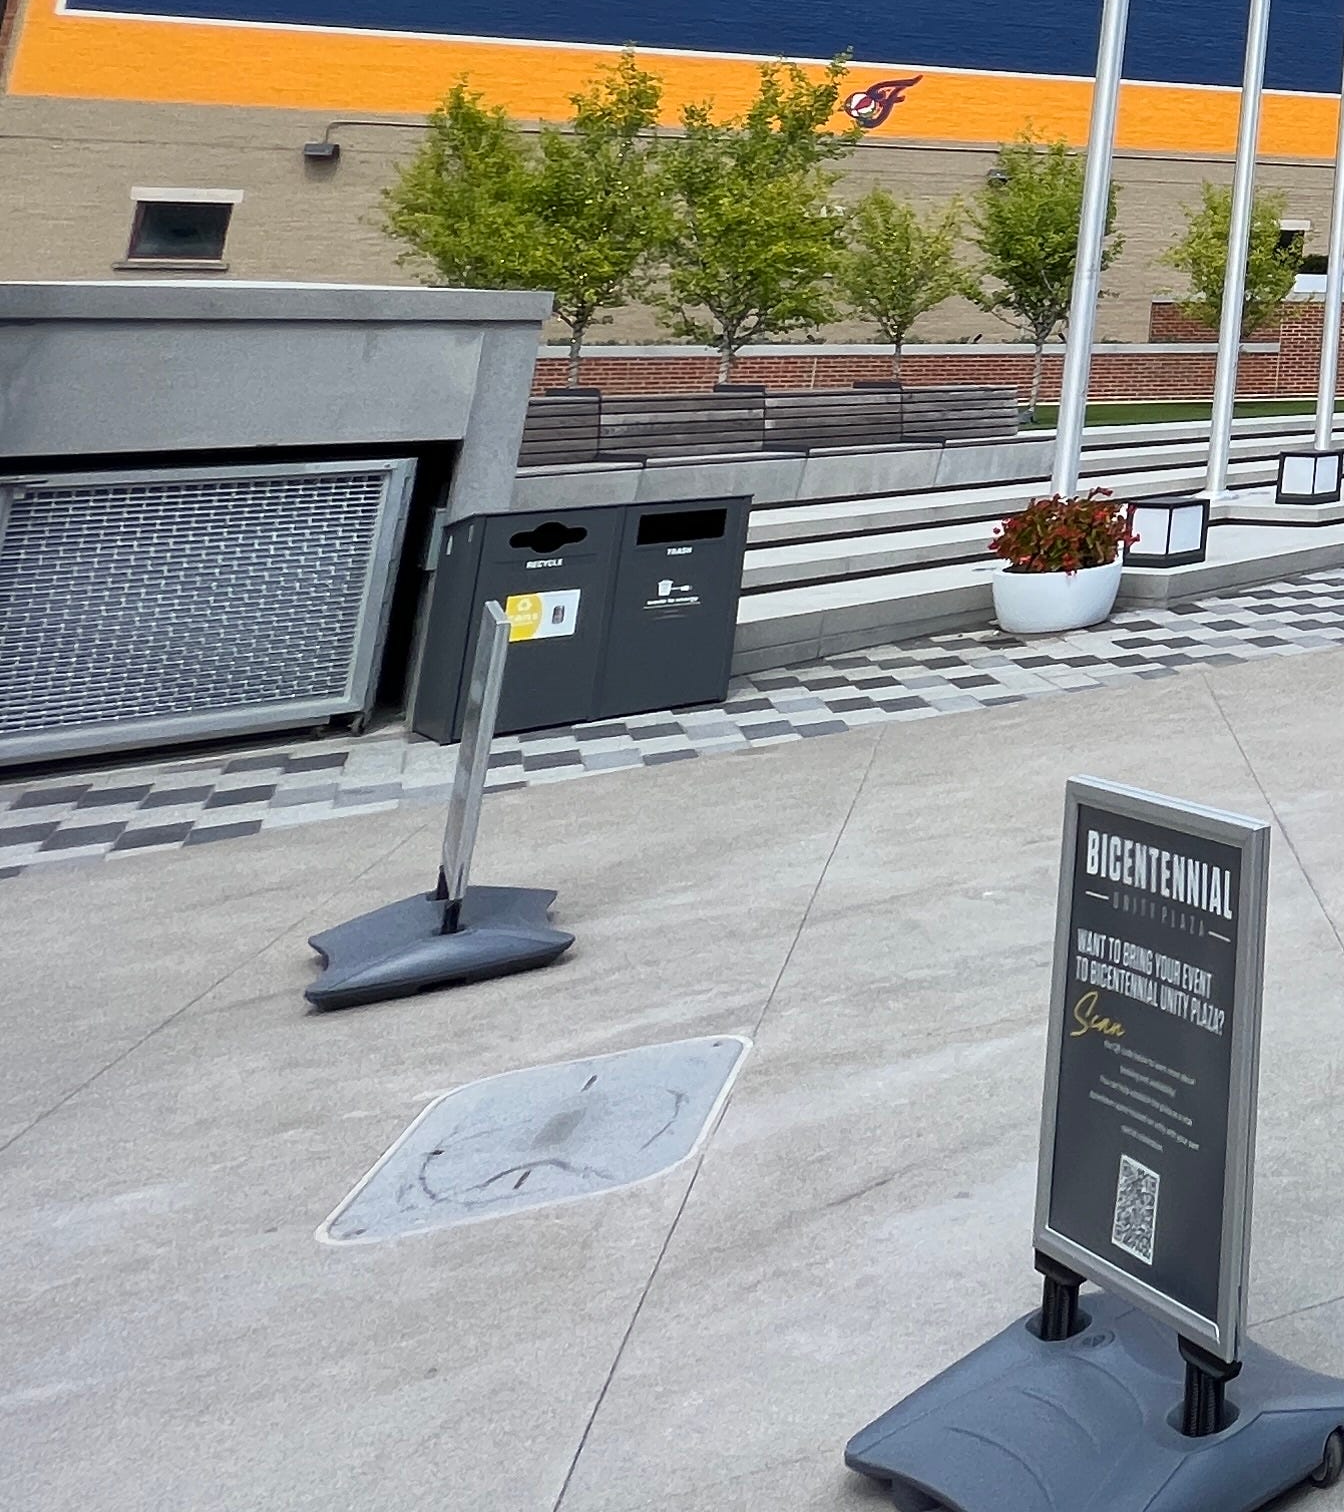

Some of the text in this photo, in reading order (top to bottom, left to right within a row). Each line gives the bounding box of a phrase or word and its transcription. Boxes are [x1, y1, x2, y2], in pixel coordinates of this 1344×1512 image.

[526, 558, 563, 568] RECYCLE
[666, 547, 693, 555] TRASH
[1086, 830, 1233, 920] BICENTENNIAL
[1075, 955, 1225, 1037] TO BICENTENNIAL UNITY PLAZA?
[1077, 928, 1213, 999] WANT TO BRING YOUR EVENT
